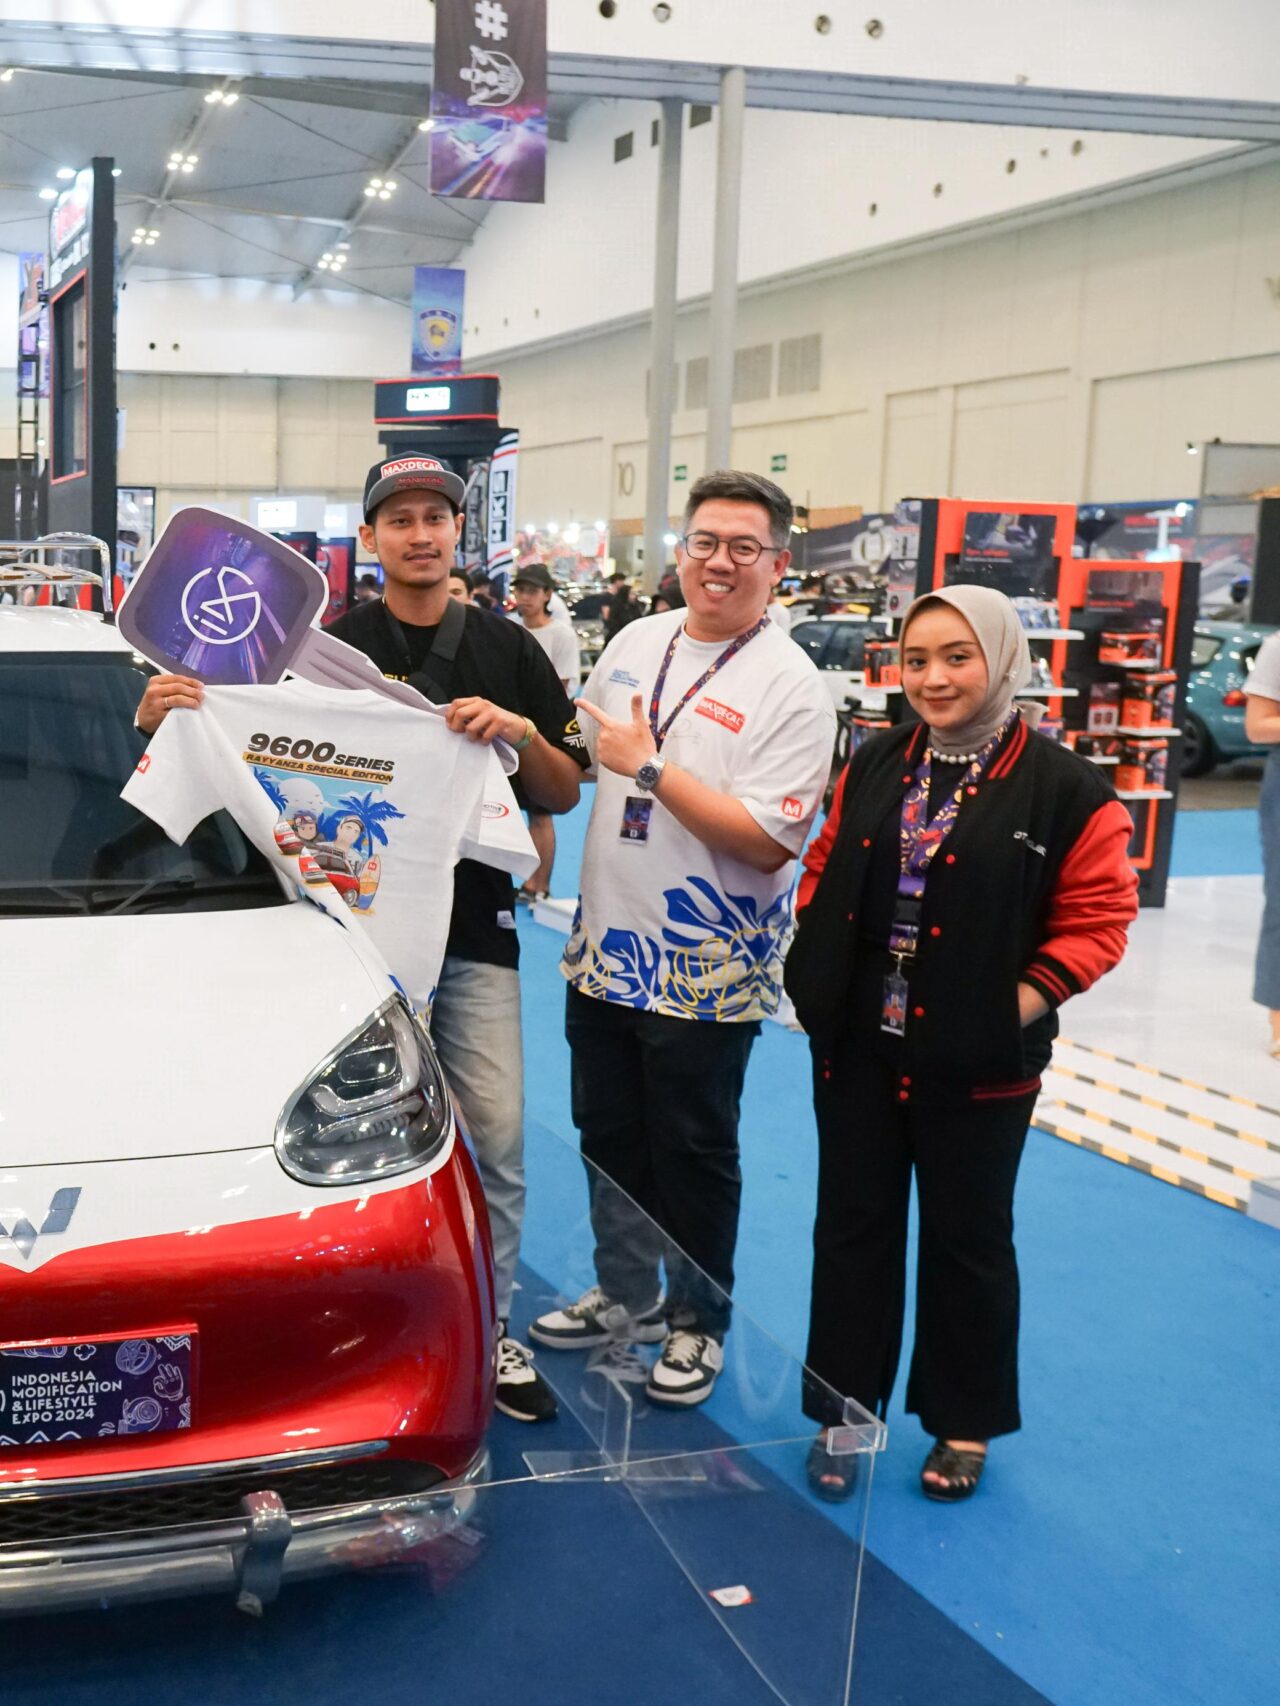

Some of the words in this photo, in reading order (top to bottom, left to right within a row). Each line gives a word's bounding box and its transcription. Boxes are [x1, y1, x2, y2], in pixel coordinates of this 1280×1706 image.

[248, 733, 336, 762] 9600
[333, 754, 395, 772] SERIES
[246, 754, 304, 770] RAYYANZA
[306, 764, 349, 776] SPECIAL
[351, 770, 393, 783] EDITION
[12, 1370, 96, 1387] INDONESIA
[12, 1380, 122, 1399] MODIFICATION
[12, 1400, 23, 1412] &
[25, 1395, 97, 1411] LIFESTYLE
[12, 1411, 53, 1425] EXPO
[55, 1408, 95, 1422] 2024
